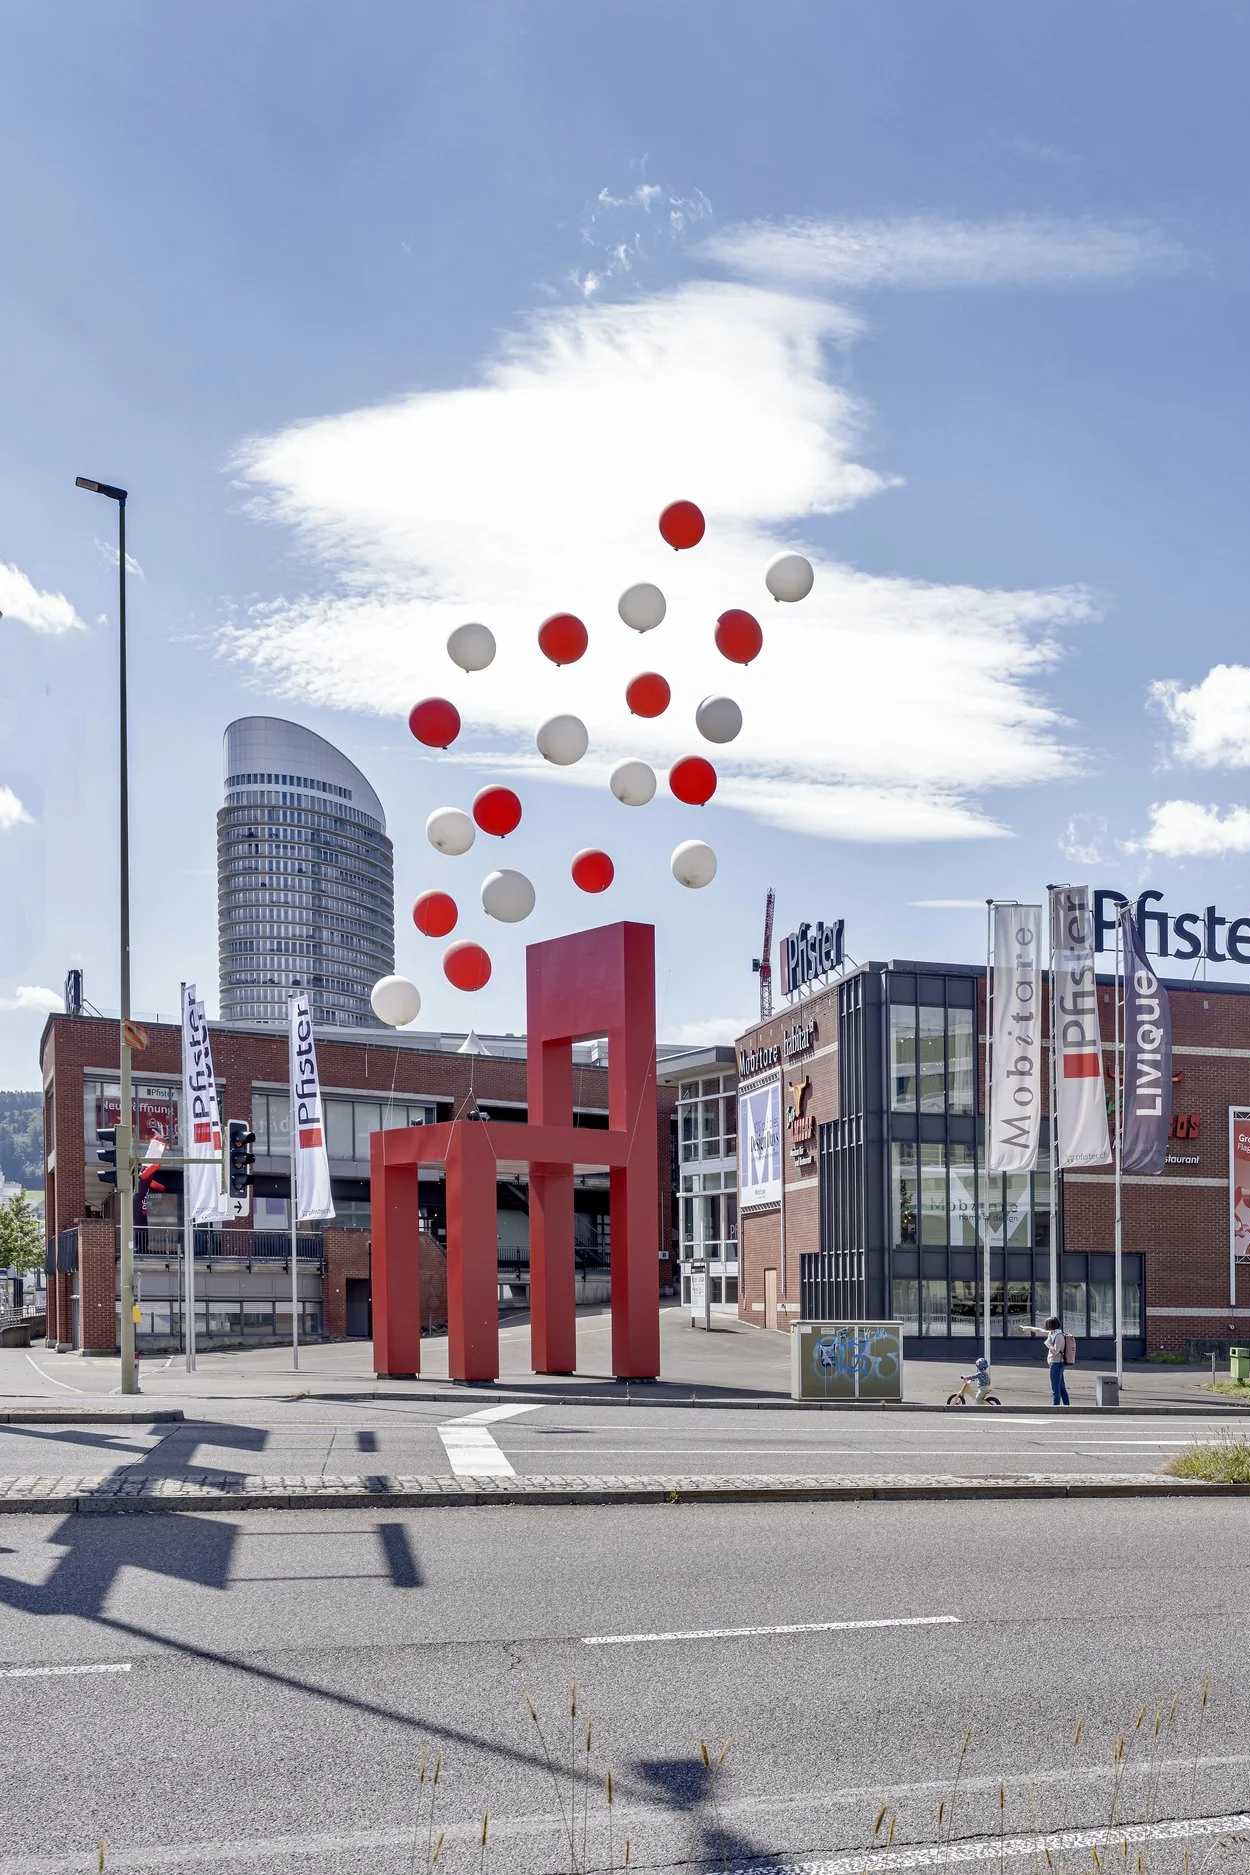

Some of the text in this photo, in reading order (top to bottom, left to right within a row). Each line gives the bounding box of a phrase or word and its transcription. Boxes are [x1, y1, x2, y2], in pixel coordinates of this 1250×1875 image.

[787, 918, 845, 992] Pfister
[1059, 894, 1097, 1049] Pfister
[189, 992, 209, 1118] Pfister
[295, 1003, 321, 1125] Pfister
[999, 927, 1034, 1150] Mobitare
